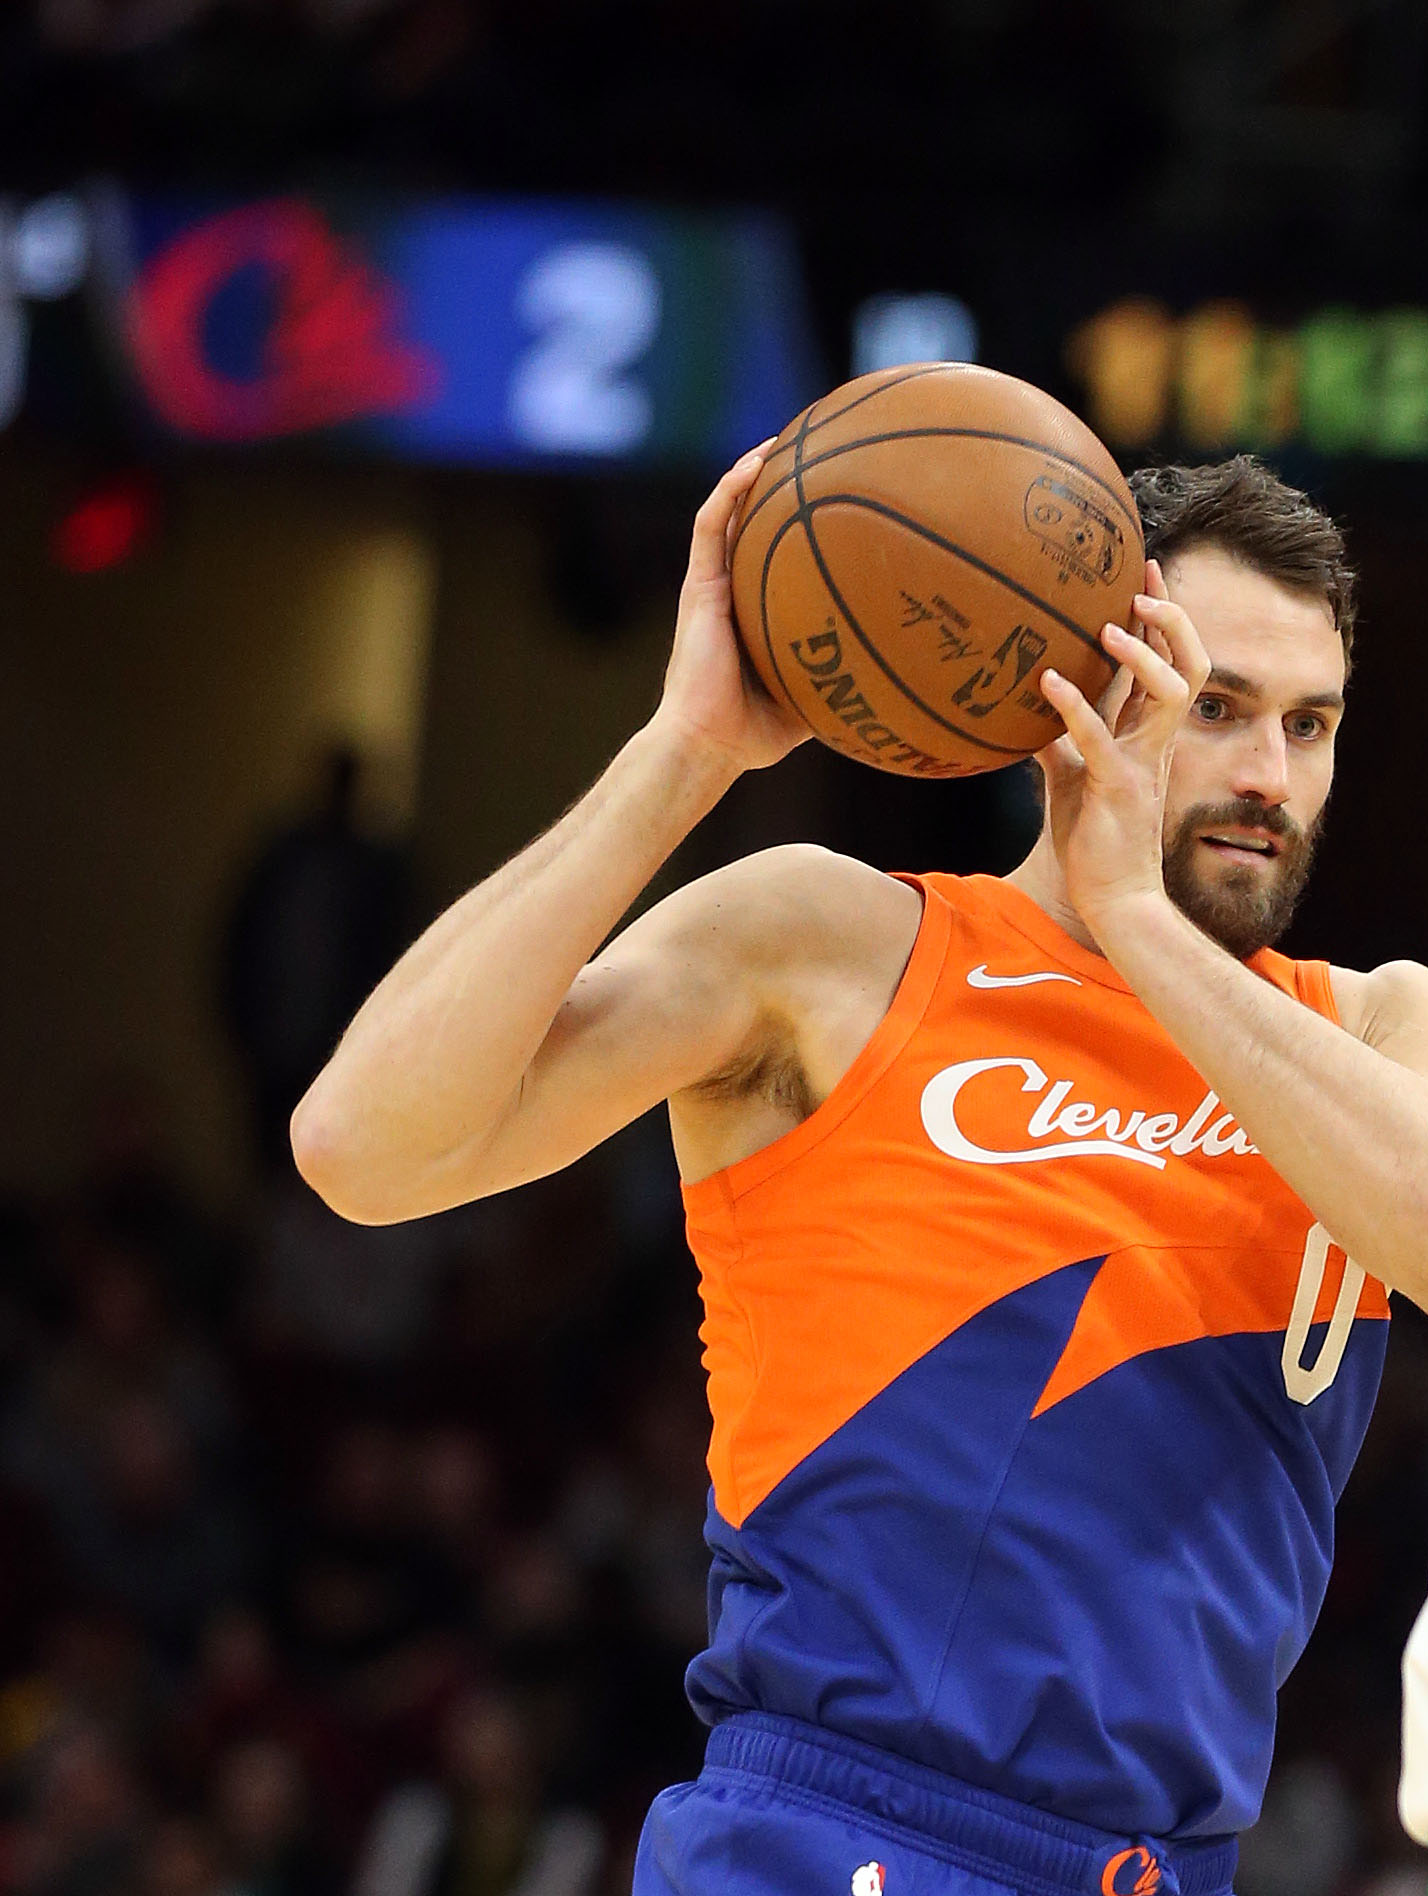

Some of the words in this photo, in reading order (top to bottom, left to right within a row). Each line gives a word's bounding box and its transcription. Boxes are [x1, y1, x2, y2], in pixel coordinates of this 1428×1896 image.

[512, 246, 660, 456] 2
[920, 1056, 1262, 1170] Clevela
[1281, 1221, 1366, 1406] 0
